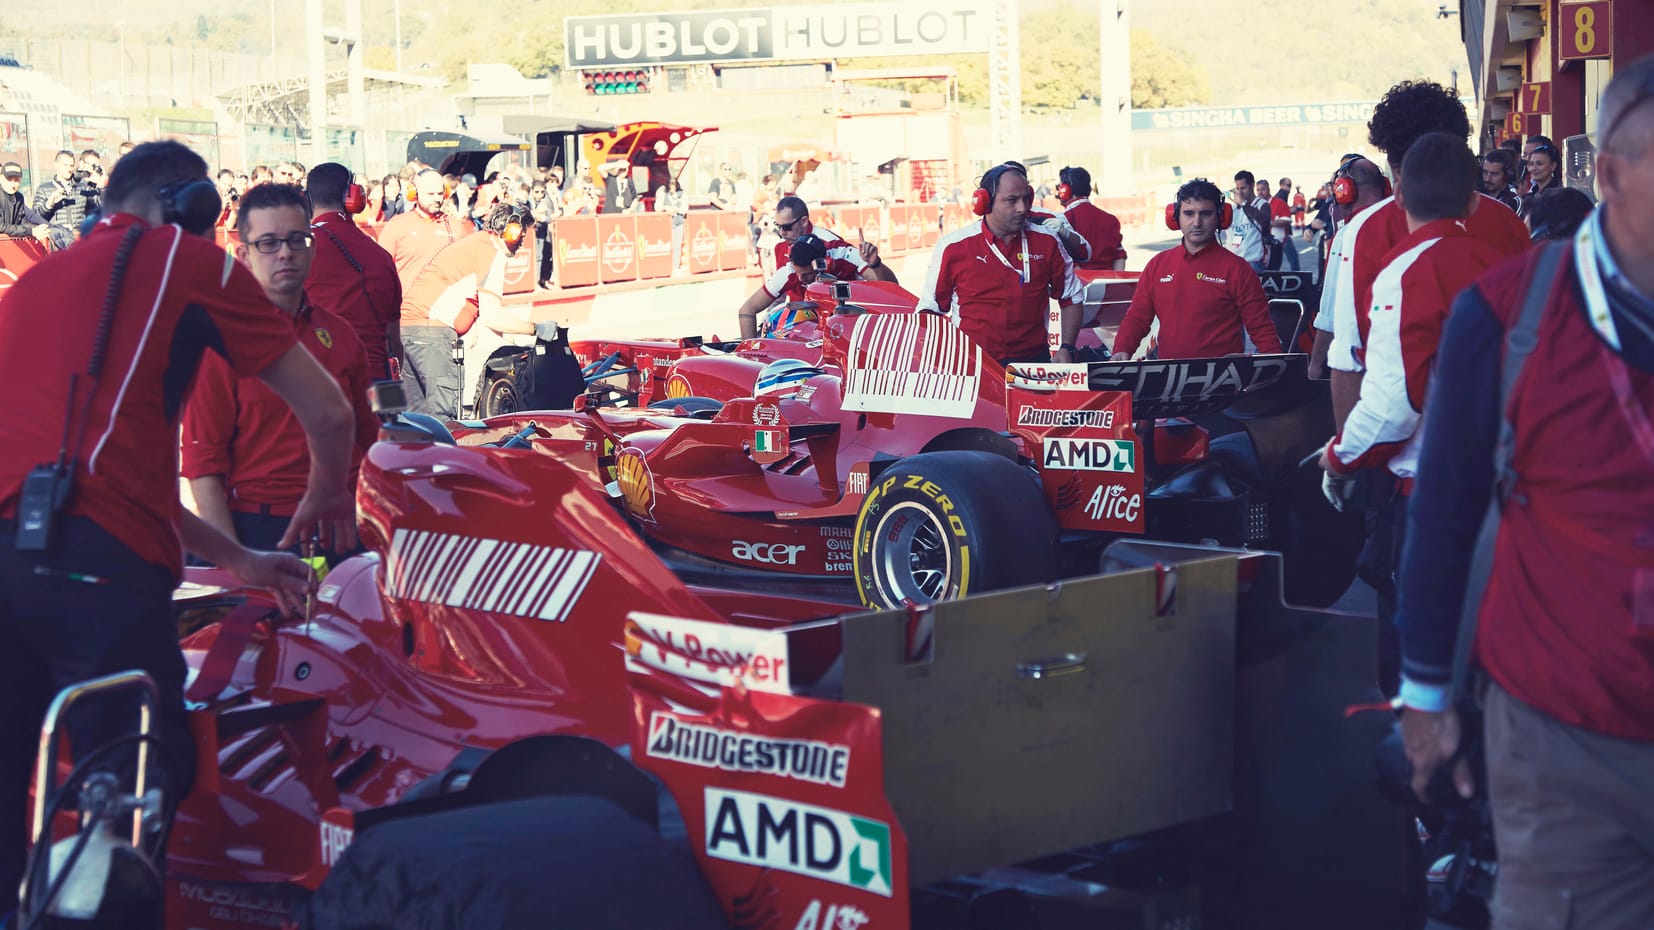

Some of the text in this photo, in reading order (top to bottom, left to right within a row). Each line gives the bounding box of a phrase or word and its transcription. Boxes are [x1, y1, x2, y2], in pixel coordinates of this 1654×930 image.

[573, 18, 767, 60] HUBLOT
[783, 10, 977, 49] HUBLOT
[1574, 6, 1596, 54] 8
[1529, 84, 1542, 112] 7
[1168, 103, 1372, 127] SINGHA BEER SING
[1512, 114, 1521, 133] 6
[1020, 366, 1088, 386] V-Power
[1088, 360, 1288, 403] ETIHAD
[1019, 406, 1113, 428] BRIDGESTONE
[1044, 440, 1111, 468] AMD
[849, 472, 868, 495] FIAT
[881, 476, 897, 498] P
[903, 474, 969, 537] ZERO
[1084, 484, 1141, 522] Alice
[820, 526, 854, 537] MAHL
[731, 540, 806, 565] acer
[827, 551, 853, 561] SK
[651, 626, 785, 683] V-Power
[649, 714, 848, 786] BRIDGESTONE
[709, 796, 843, 873] AMD
